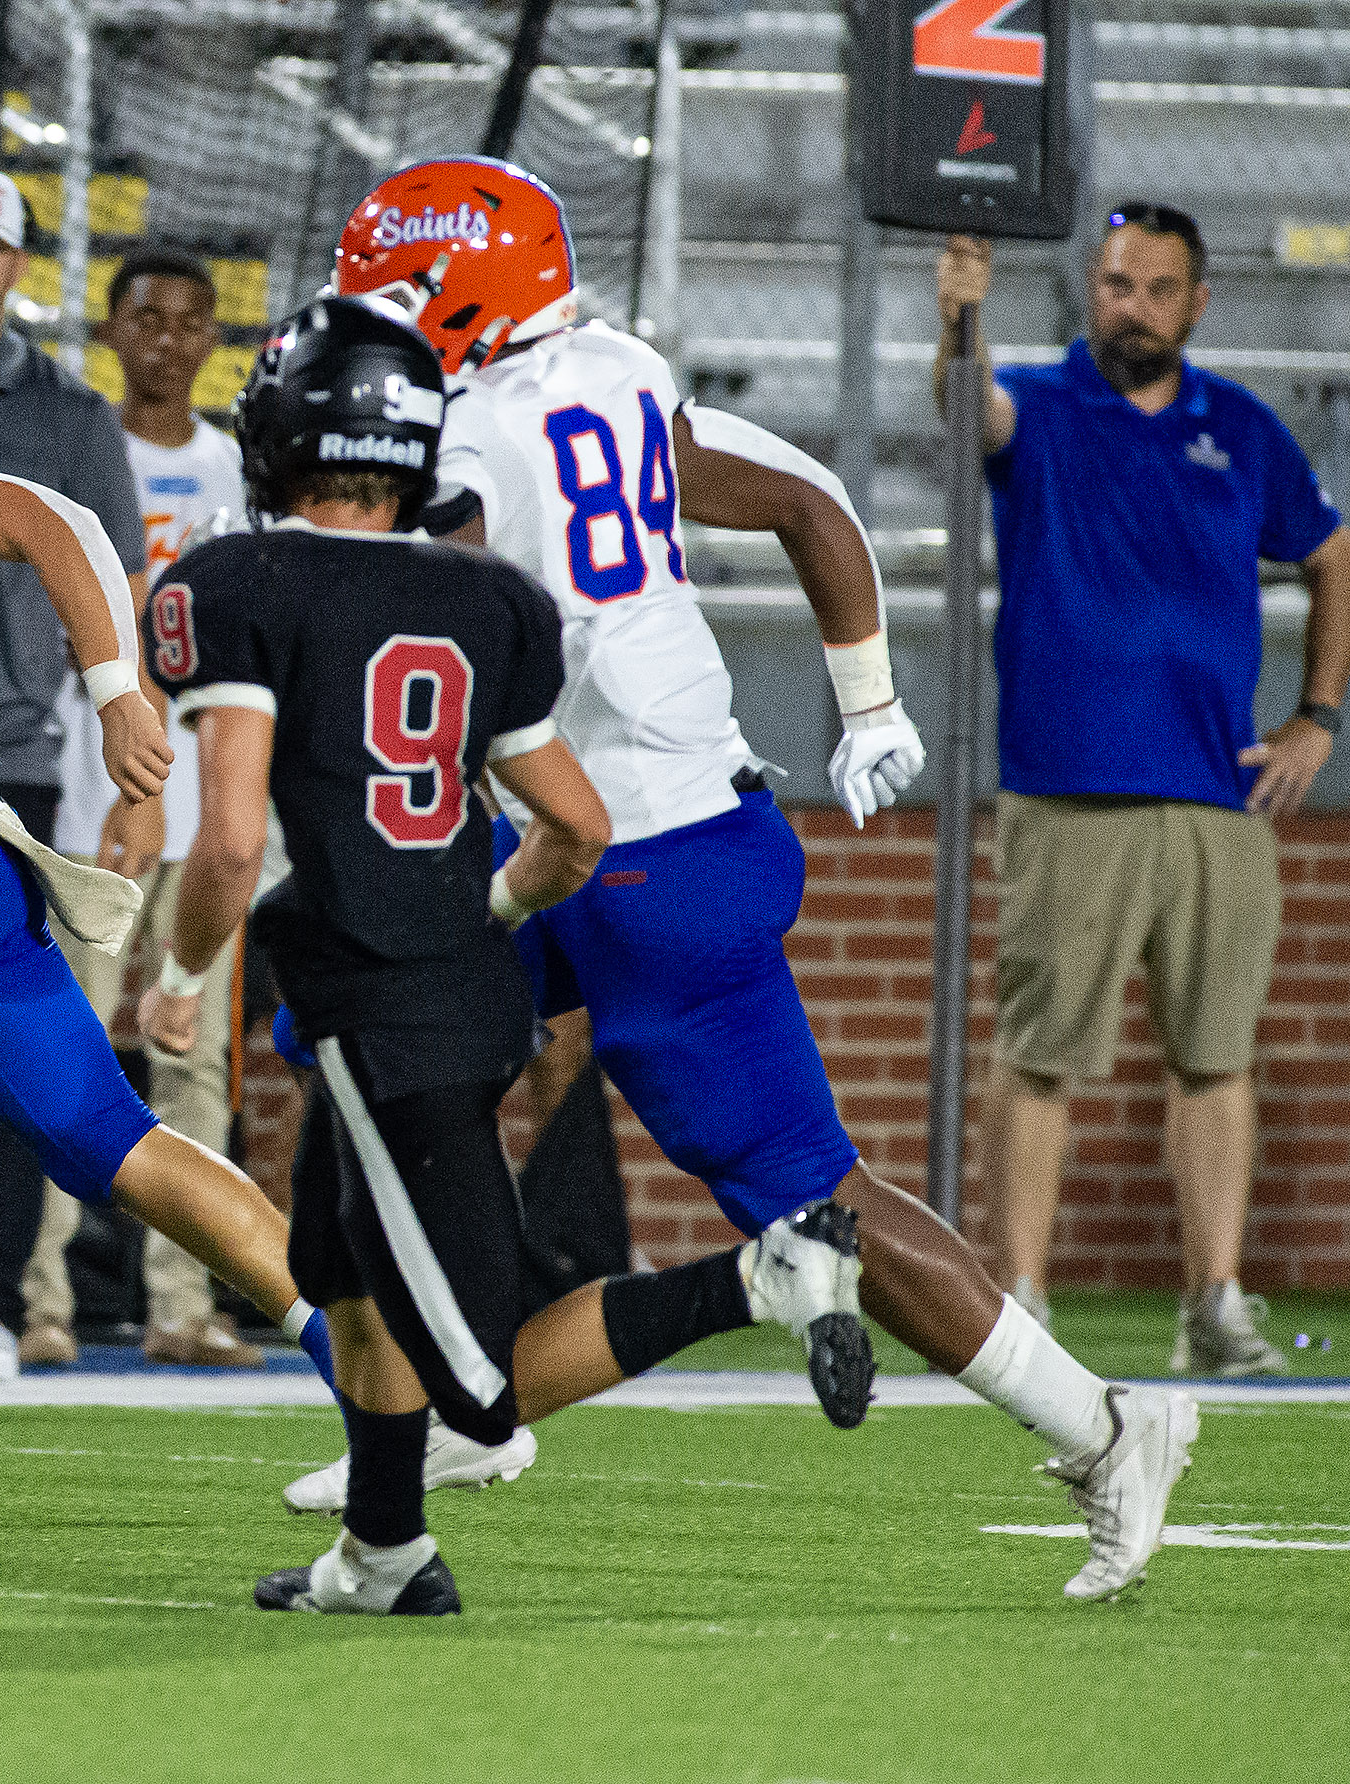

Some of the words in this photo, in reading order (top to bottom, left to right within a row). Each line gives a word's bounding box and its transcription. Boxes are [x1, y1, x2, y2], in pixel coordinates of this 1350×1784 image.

[378, 203, 490, 249] Saints
[318, 432, 426, 469] Riddell
[542, 388, 688, 606] 84
[152, 582, 201, 681] 9
[363, 634, 475, 850] 9
